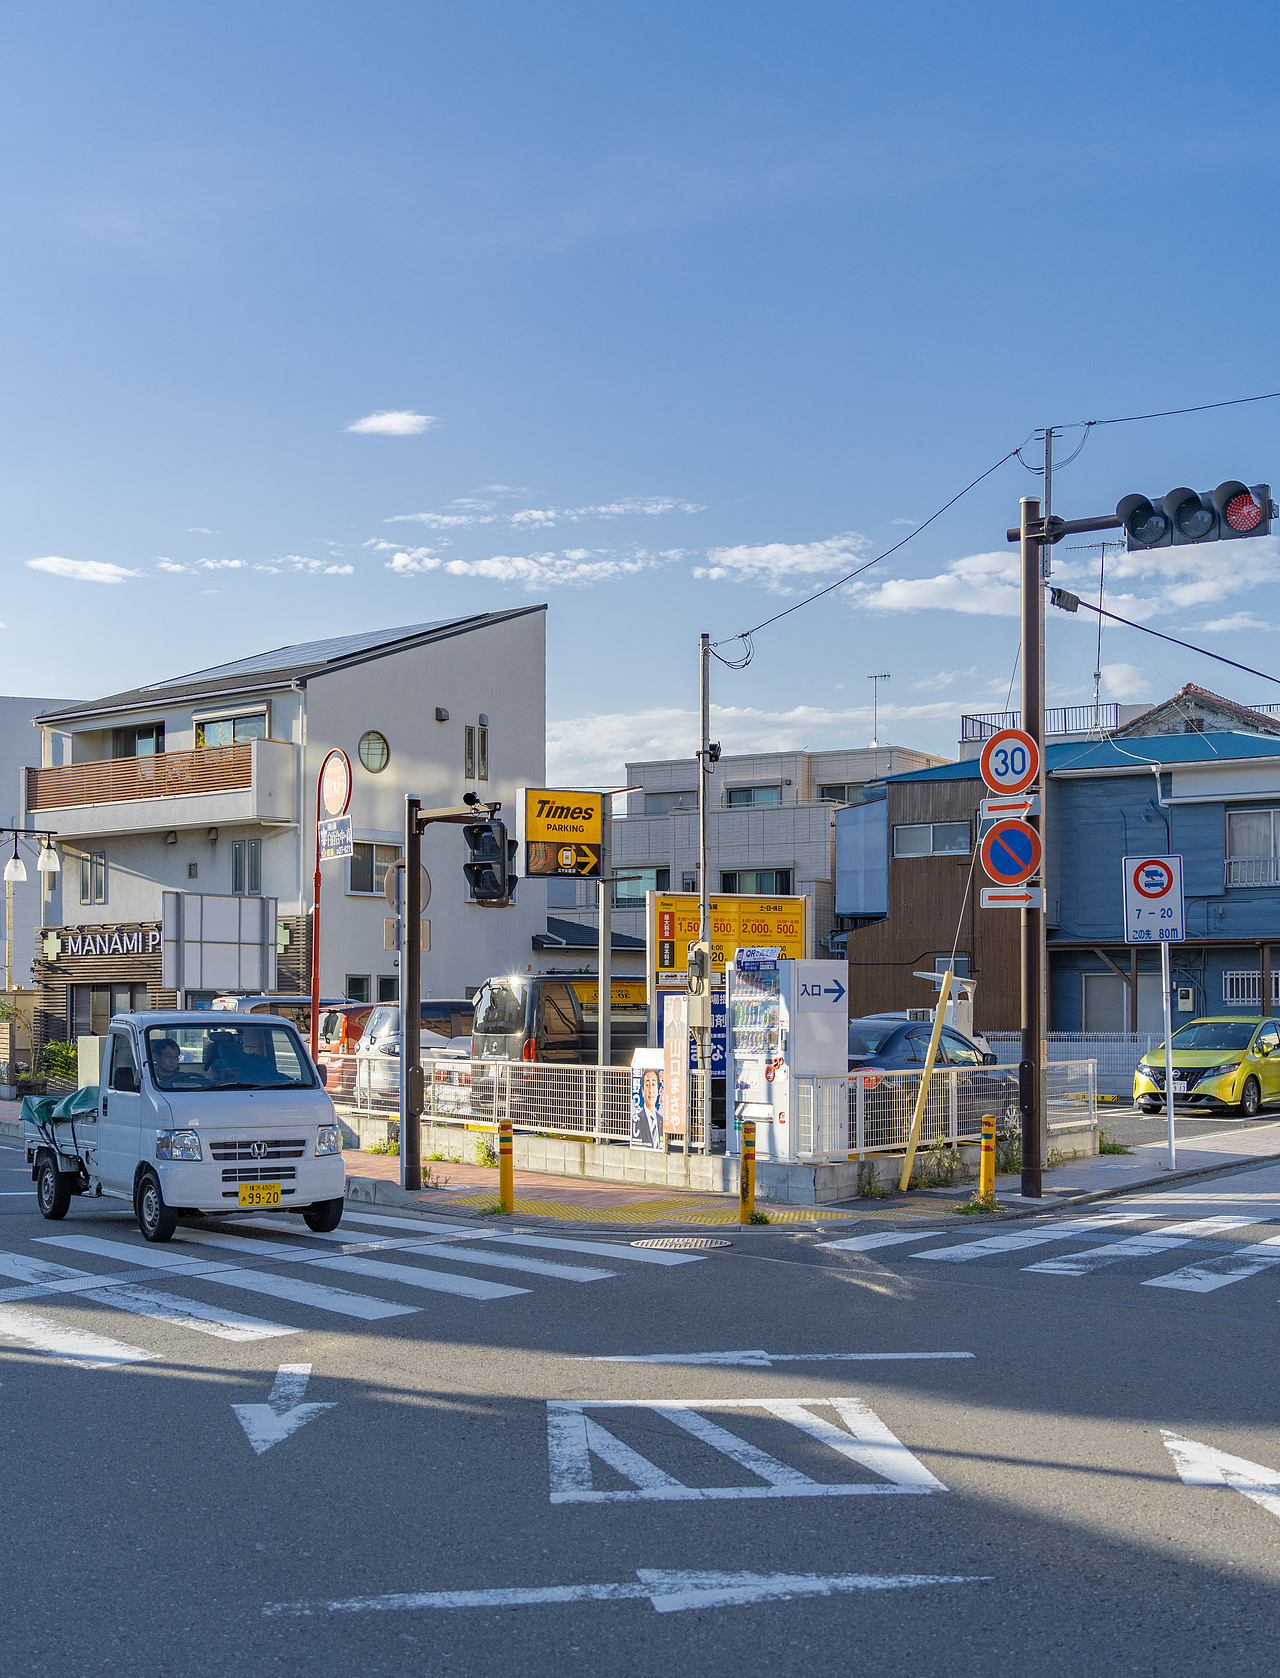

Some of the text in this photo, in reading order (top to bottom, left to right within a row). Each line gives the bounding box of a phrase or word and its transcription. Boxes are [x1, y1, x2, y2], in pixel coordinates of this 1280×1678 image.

[994, 746, 1026, 777] 30
[536, 800, 594, 820] Times
[546, 823, 584, 833] PARKING
[1135, 909, 1142, 919] 7
[1160, 907, 1173, 919] 20
[1132, 928, 1179, 939] この先 80m
[68, 931, 163, 956] MANAMI P
[800, 983, 821, 997] 入口
[248, 1192, 279, 1204] 99-20
